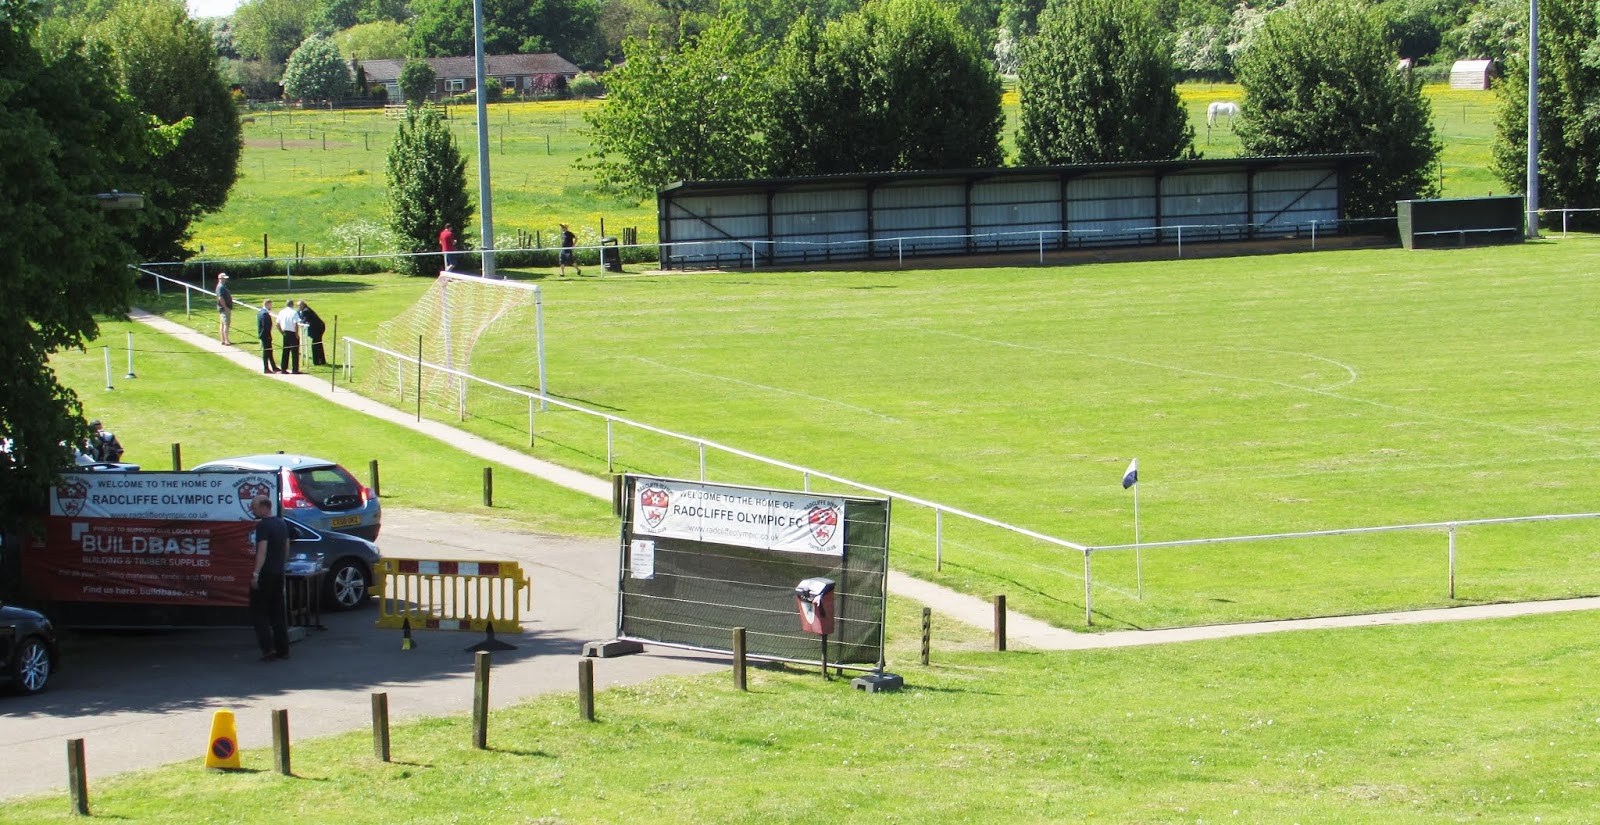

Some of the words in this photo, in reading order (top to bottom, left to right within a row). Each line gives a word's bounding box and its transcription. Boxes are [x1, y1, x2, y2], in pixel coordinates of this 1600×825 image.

[98, 480, 145, 488] WELCOME
[146, 480, 159, 488] TO
[161, 480, 179, 488] THE
[181, 480, 208, 488] HOME
[210, 480, 223, 488] OF
[93, 494, 159, 505] RADCLIFFE
[161, 494, 214, 505] OLYMPIC
[217, 495, 233, 505] FC
[680, 489, 721, 502] WELCOME
[723, 494, 735, 503] TO
[737, 496, 753, 506] THE
[755, 498, 780, 509] HOME
[782, 501, 795, 510] OF
[673, 504, 734, 521] RADCLIFFE
[737, 511, 786, 528] OLYMPIC
[788, 517, 804, 529] FC
[688, 524, 780, 542] www.radcliffeolympic.co.uk
[82, 535, 211, 555] BUILDBASE
[82, 556, 123, 565] BUILDING
[125, 557, 132, 565] &
[134, 557, 167, 566] TIMBER
[169, 558, 211, 568] SUPPLIES
[200, 574, 212, 582] DIY
[213, 575, 235, 583] needs
[83, 586, 101, 594] Find
[103, 587, 113, 595] us
